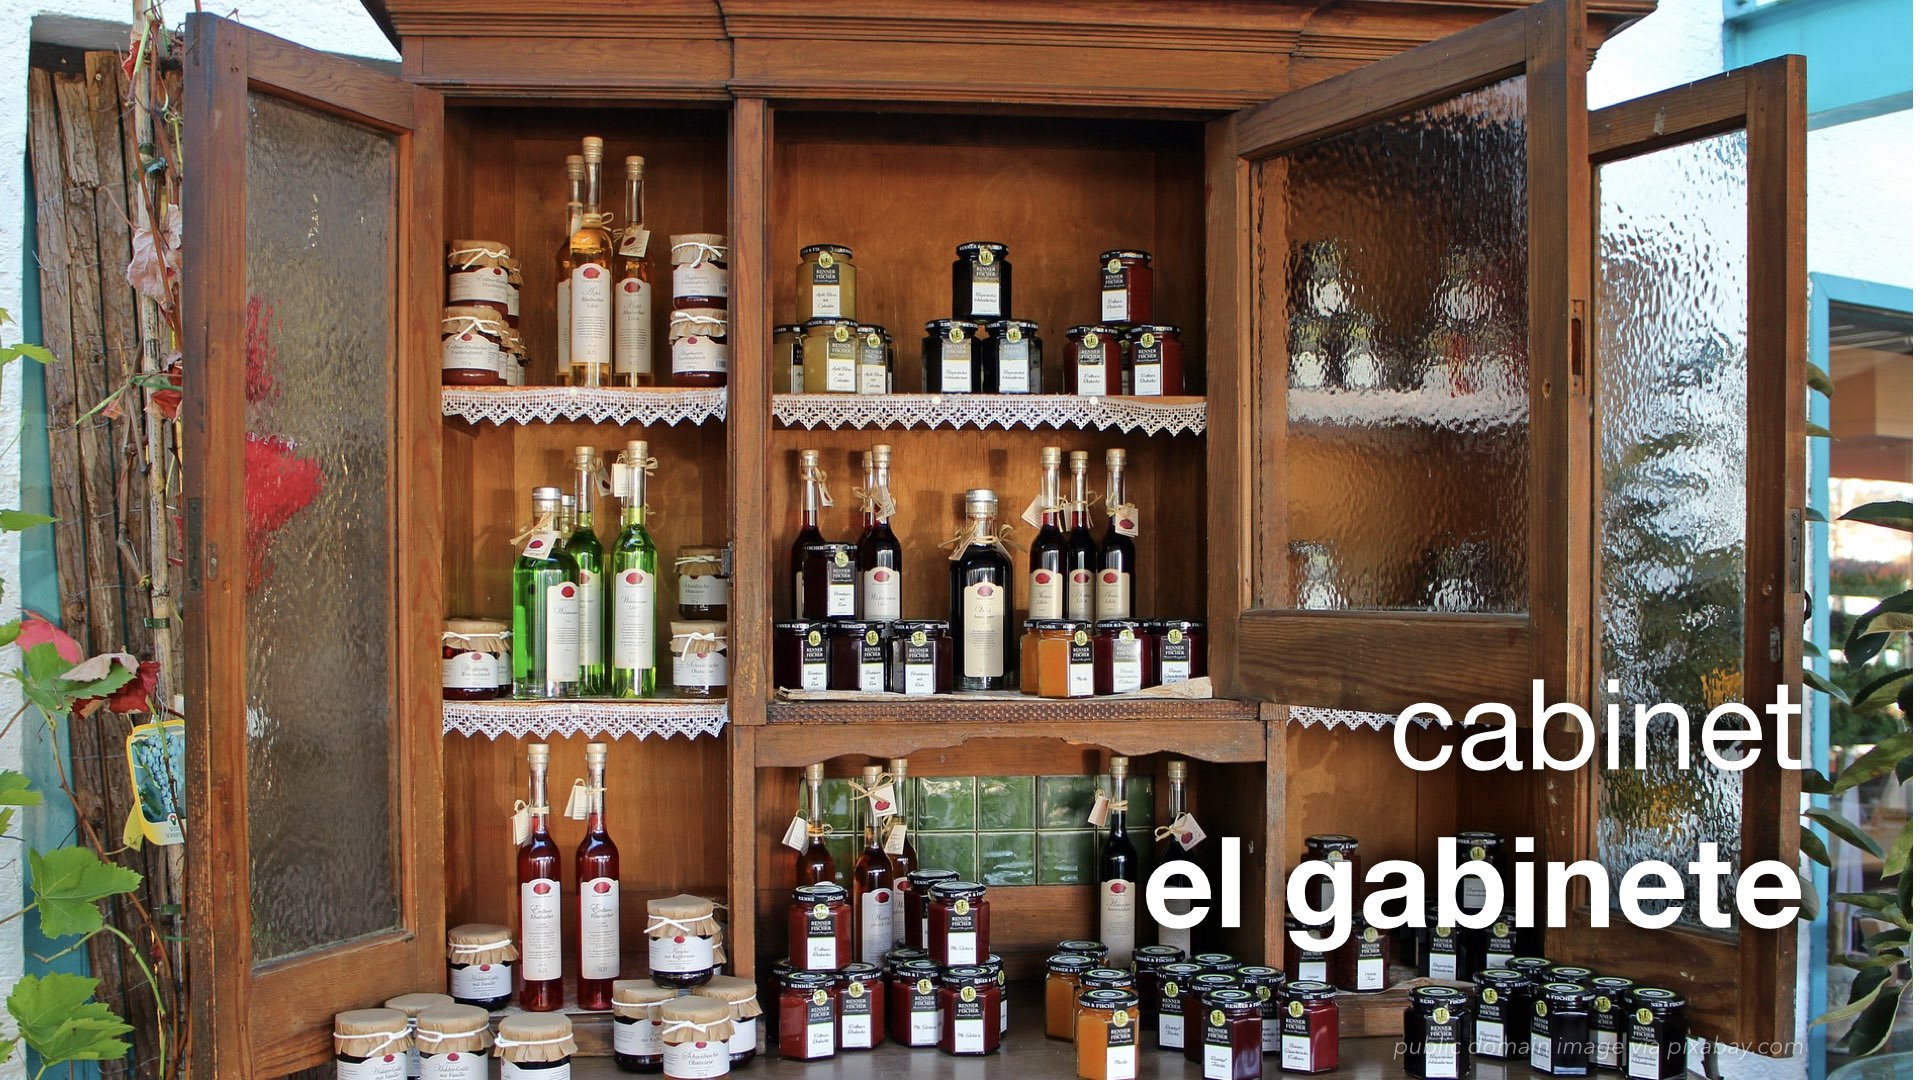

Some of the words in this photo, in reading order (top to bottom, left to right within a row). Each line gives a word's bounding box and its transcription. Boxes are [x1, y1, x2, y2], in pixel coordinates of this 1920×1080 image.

[1285, 1017, 1306, 1025] RENNER
[1285, 1023, 1306, 1031] FISCHER
[1633, 1025, 1655, 1033] RENNER
[1633, 1031, 1655, 1039] FISCHER
